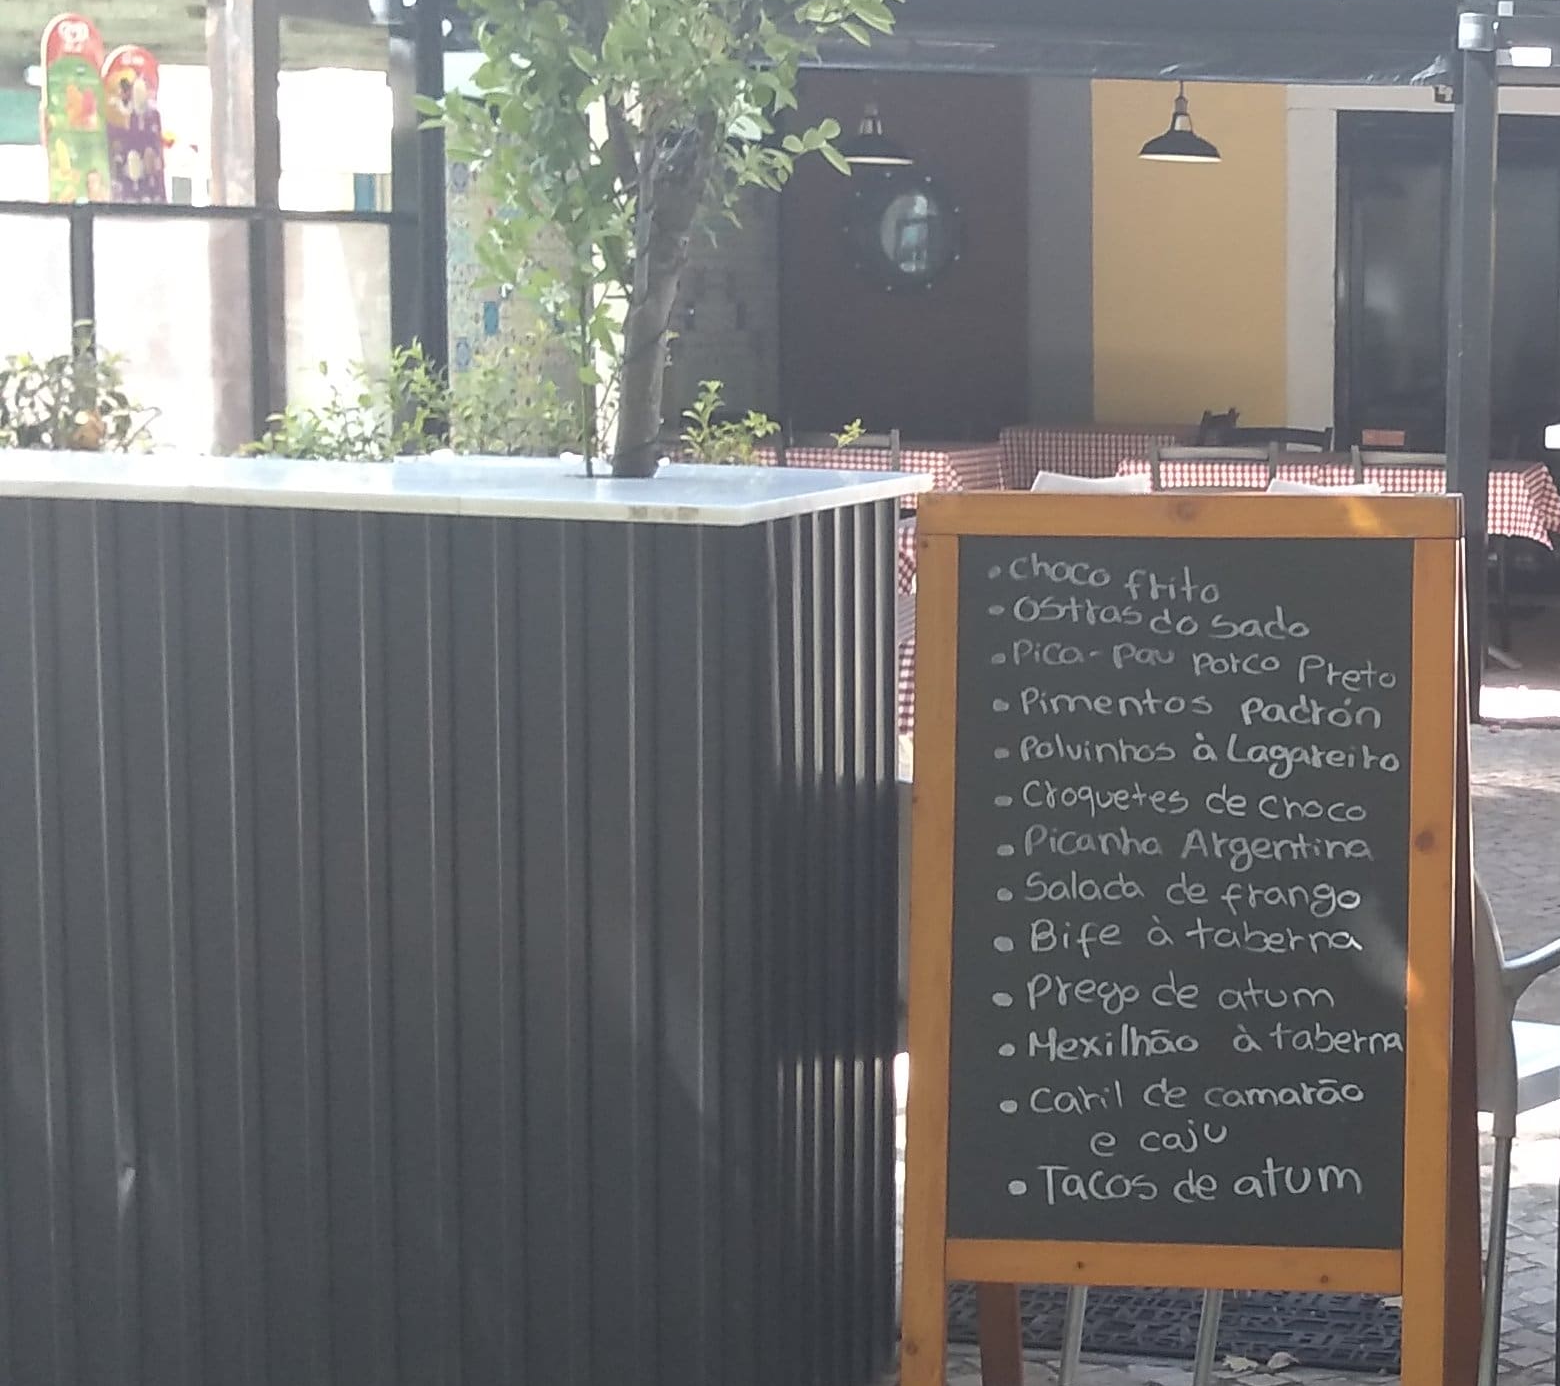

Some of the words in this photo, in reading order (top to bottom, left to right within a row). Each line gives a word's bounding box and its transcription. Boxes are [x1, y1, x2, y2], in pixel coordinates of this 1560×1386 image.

[1124, 565, 1219, 603] frito
[1013, 596, 1142, 625] Ostras
[1150, 608, 1198, 635] do
[1021, 686, 1213, 716] Pimentos
[1020, 733, 1176, 762] Polvinhos
[1227, 733, 1400, 779] Lagareiro
[1023, 780, 1189, 817] Croquetes
[1205, 783, 1247, 816] de
[1024, 824, 1162, 856] Picanha
[1180, 829, 1374, 872] Argentina
[1024, 871, 1144, 901] Salada
[1166, 872, 1208, 905] de
[1221, 883, 1361, 917] frango
[1029, 918, 1122, 958] Bife
[1147, 915, 1174, 946] à
[1185, 917, 1363, 954] taberna
[1027, 973, 1140, 1014] Prego
[1152, 970, 1199, 1009] de
[1218, 977, 1334, 1010] atum
[1028, 1024, 1199, 1061] Mexilhão
[1233, 1024, 1262, 1053] à
[1270, 1022, 1403, 1056] taberna
[1030, 1080, 1123, 1114] Caril
[1143, 1077, 1187, 1108] de
[1204, 1078, 1365, 1108] camarão
[1090, 1131, 1116, 1157] e
[1139, 1119, 1229, 1152] caju
[1037, 1165, 1158, 1205] Tacos
[1173, 1168, 1218, 1203] de
[1233, 1156, 1363, 1198] atum
